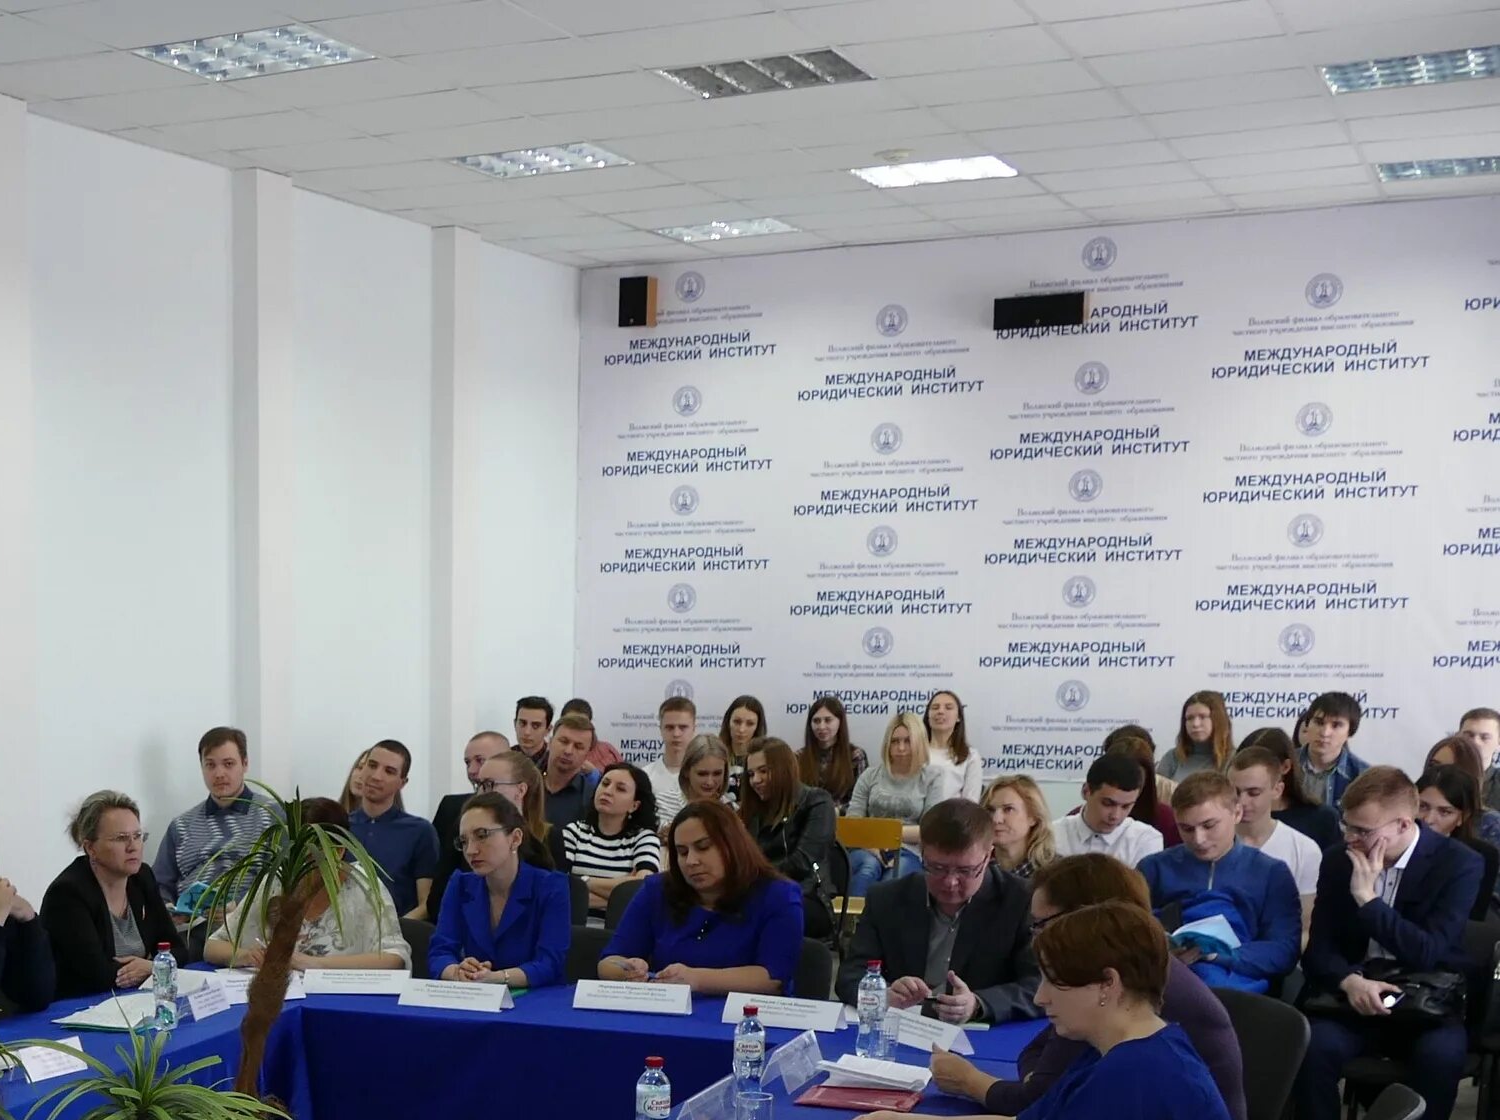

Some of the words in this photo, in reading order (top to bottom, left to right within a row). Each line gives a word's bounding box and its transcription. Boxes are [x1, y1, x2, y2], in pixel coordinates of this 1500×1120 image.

[1090, 301, 1168, 319] АРОДНЫЙ
[1119, 316, 1199, 331] ИНСТИТУТ
[630, 332, 750, 350] МЕЖДУНАРОДНЫЙ
[605, 349, 701, 365] ЮРИДИЧЕСКИЙ
[709, 344, 776, 358] ИНСТИТУТ
[1244, 342, 1397, 361] МЕЖДУНАРОДНЫЙ
[1212, 361, 1334, 379] ЮРИДИЧЕСКИЙ
[1345, 356, 1429, 371] ИНСТИТУТ
[826, 367, 956, 385] МЕЖДУНАРОДНЫЙ
[798, 384, 902, 401] ЮРИДИЧЕСКИЙ
[912, 380, 984, 395] ИНСТИТУТ
[1020, 427, 1159, 444] МЕЖДУНАРОДНЫЙ
[627, 447, 746, 462] МЕЖДУНАРОДНЫЙ
[990, 443, 1102, 460] ЮРИДИЧЕСКИЙ
[1112, 441, 1189, 455] ИНСТИТУТ
[602, 463, 698, 477] ЮРИДИЧЕСКИЙ
[706, 459, 772, 472] ИНСТИТУТ
[1235, 471, 1386, 487] МЕЖДУНАРОДНЫЙ
[821, 486, 950, 501] МЕЖДУНАРОДНЫЙ
[1203, 489, 1324, 504] ЮРИДИЧЕСКИЙ
[1335, 485, 1418, 498] ИНСТИТУТ
[794, 503, 897, 516] ЮРИДИЧЕСКИЙ
[906, 500, 978, 512] ИНСТИТУТ
[1014, 536, 1152, 550] МЕЖДУНАРОДНЫЙ
[625, 546, 743, 560] МЕЖДУНАРОДНЫЙ
[985, 550, 1096, 565] ЮРИДИЧЕСКИЙ
[1105, 550, 1182, 562] ИНСТИТУТ
[601, 559, 695, 573] ЮРИДИЧЕСКИЙ
[703, 559, 769, 570] ИНСТИТУТ
[817, 590, 944, 603] МЕЖДУНАРОДНЫЙ
[1227, 583, 1376, 597] МЕЖДУНАРОДНЫЙ
[790, 605, 892, 617] ЮРИДИЧЕСКИЙ
[902, 603, 972, 614] ИНСТИТУТ
[1196, 599, 1315, 612] ЮРИДИЧЕСКИЙ
[1326, 598, 1408, 609] ИНСТИТУТ
[623, 642, 740, 657] МЕЖДУНАРОДНЫЙ
[1008, 640, 1145, 655] МЕЖДУНАРОДНЫЙ
[598, 656, 692, 669] ЮРИДИЧЕСКИЙ
[701, 658, 765, 667] ИНСТИТУТ
[979, 657, 1089, 669] ЮРИДИЧЕСКИЙ
[1099, 656, 1174, 667] ИНСТИТУТ
[786, 702, 888, 714] ЮРЕСКИЙ
[1228, 706, 1308, 719] ДИЧЕСКИЙ
[1002, 744, 1104, 756] МЕЖДУНАРОД
